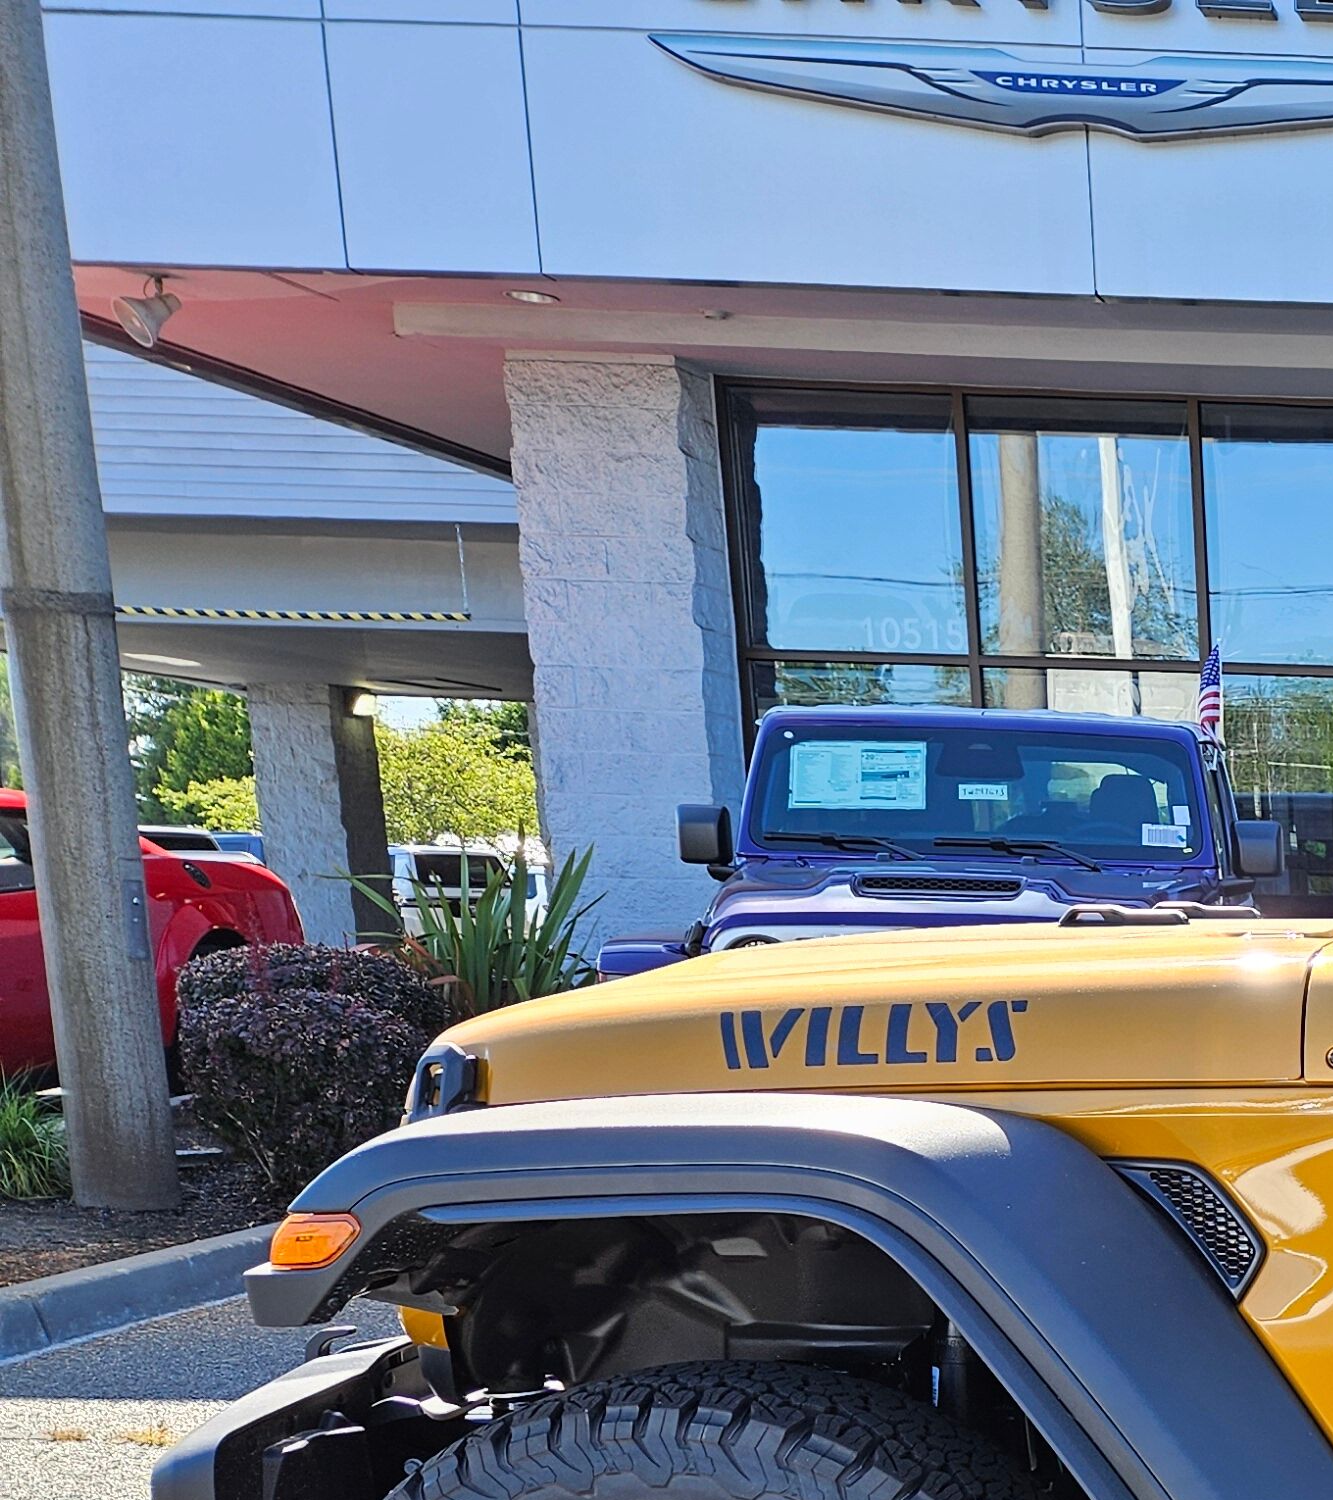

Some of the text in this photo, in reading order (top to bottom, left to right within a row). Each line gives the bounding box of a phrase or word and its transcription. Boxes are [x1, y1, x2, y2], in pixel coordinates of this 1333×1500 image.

[995, 75, 1158, 94] CHRYSLER
[863, 617, 965, 651] 10515
[720, 1000, 1028, 1069] WILLYS
